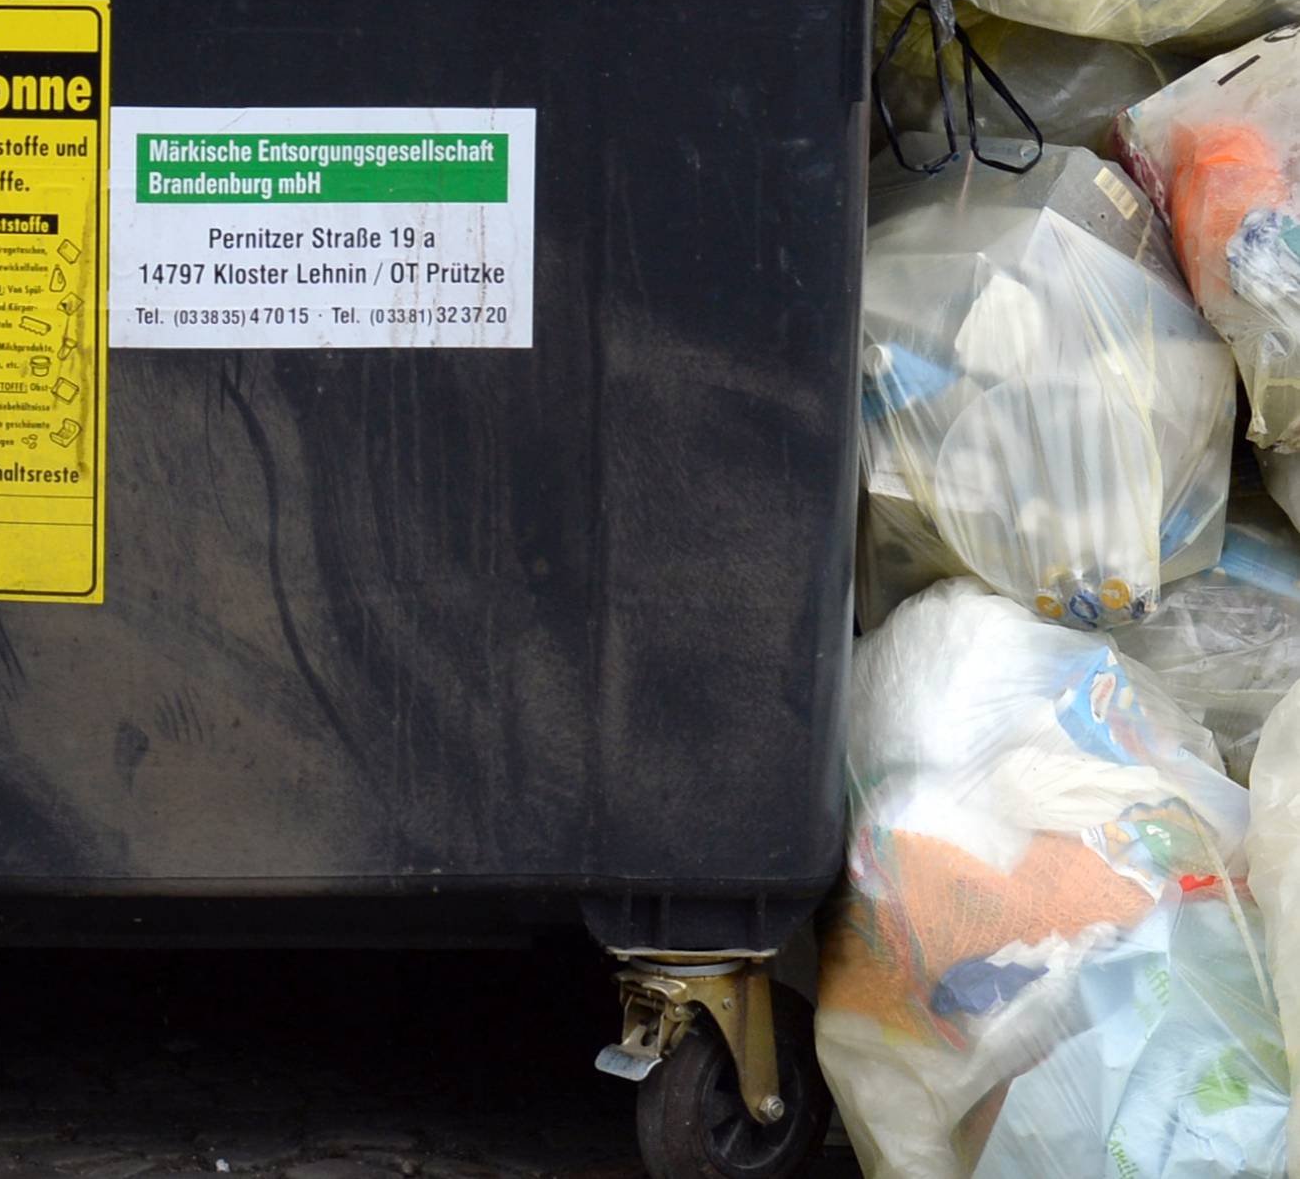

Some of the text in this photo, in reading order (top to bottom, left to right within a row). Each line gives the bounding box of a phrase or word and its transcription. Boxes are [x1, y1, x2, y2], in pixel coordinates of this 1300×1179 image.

[56, 136, 88, 157] und
[148, 139, 494, 168] Märkische Entsorgungsgesellschaft
[149, 171, 321, 199] Brandenburg mbH
[208, 227, 435, 249] Pernitzer Straße 19 a
[138, 261, 505, 285] 14797 Kloster Lehnin OT Prützke
[136, 307, 164, 324] Tel.
[332, 307, 361, 324] Tel.
